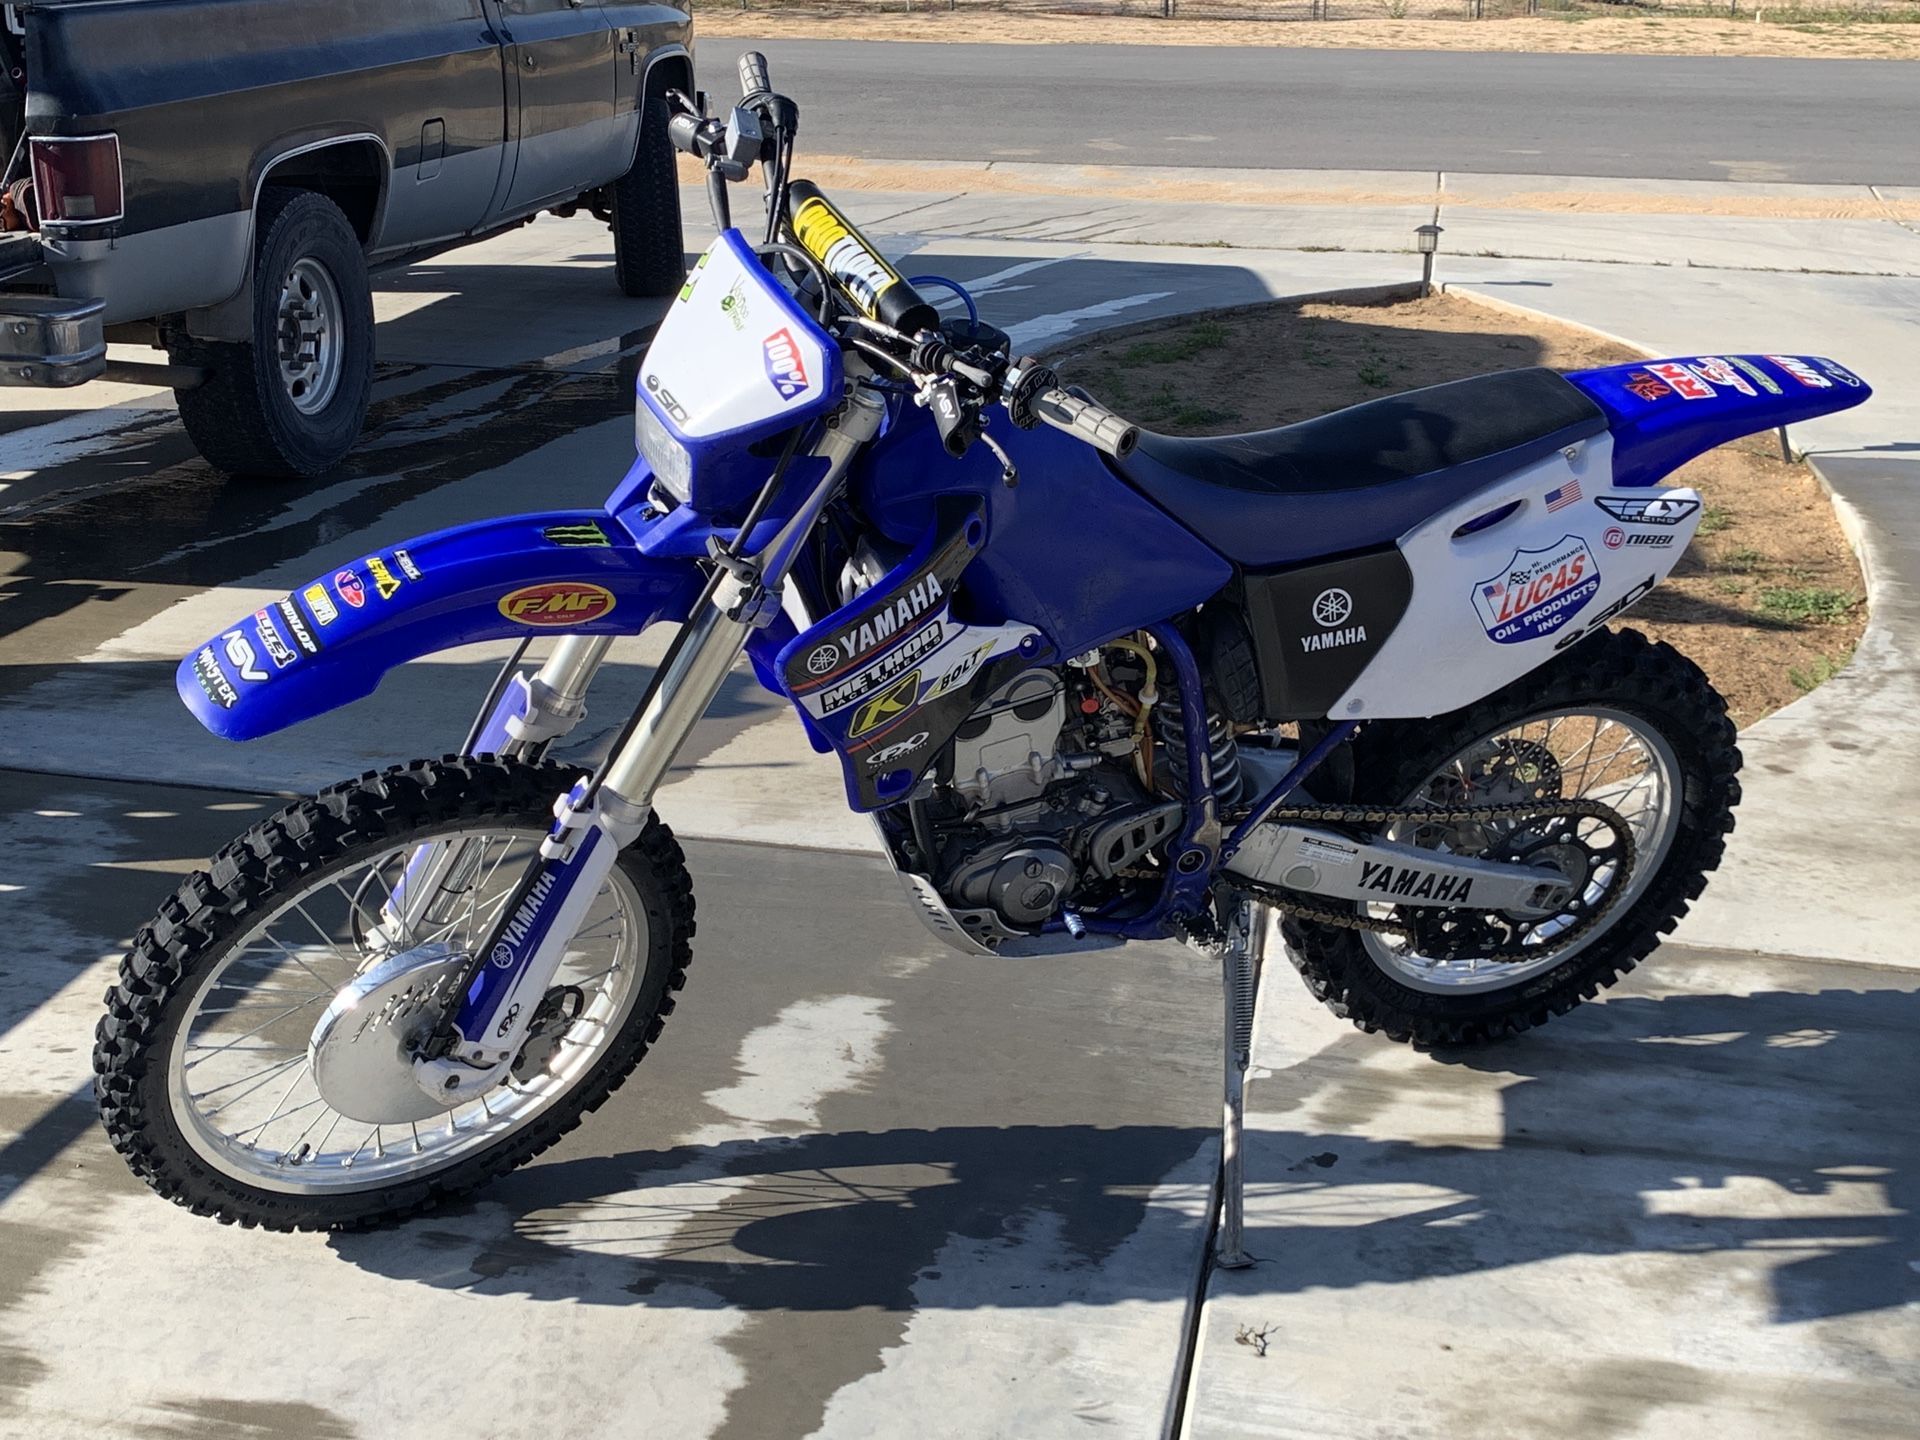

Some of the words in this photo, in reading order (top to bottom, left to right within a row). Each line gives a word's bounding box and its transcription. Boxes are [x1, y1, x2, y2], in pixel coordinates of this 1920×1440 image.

[764, 333, 809, 395] 100%
[1651, 365, 1708, 397] RK
[1620, 515, 1676, 524] RACING
[1535, 544, 1585, 575] PERFORMANCE
[509, 591, 606, 615] FMF
[840, 571, 944, 659] YAMAHA
[1494, 623, 1521, 640] OIL
[1523, 580, 1598, 627] PRODUCTS
[1497, 554, 1586, 624] LUCAS
[280, 600, 317, 653] DUNLOP
[1301, 625, 1367, 653] YAMAHA
[198, 646, 238, 708] MONSTER
[222, 629, 269, 680] ASV
[823, 623, 940, 706] METHOD
[825, 686, 869, 711] RACE
[878, 635, 941, 683] WHEELS
[940, 647, 982, 691] BOLT
[1357, 861, 1475, 903] YAMAHA
[501, 871, 557, 948] YAMAHA
